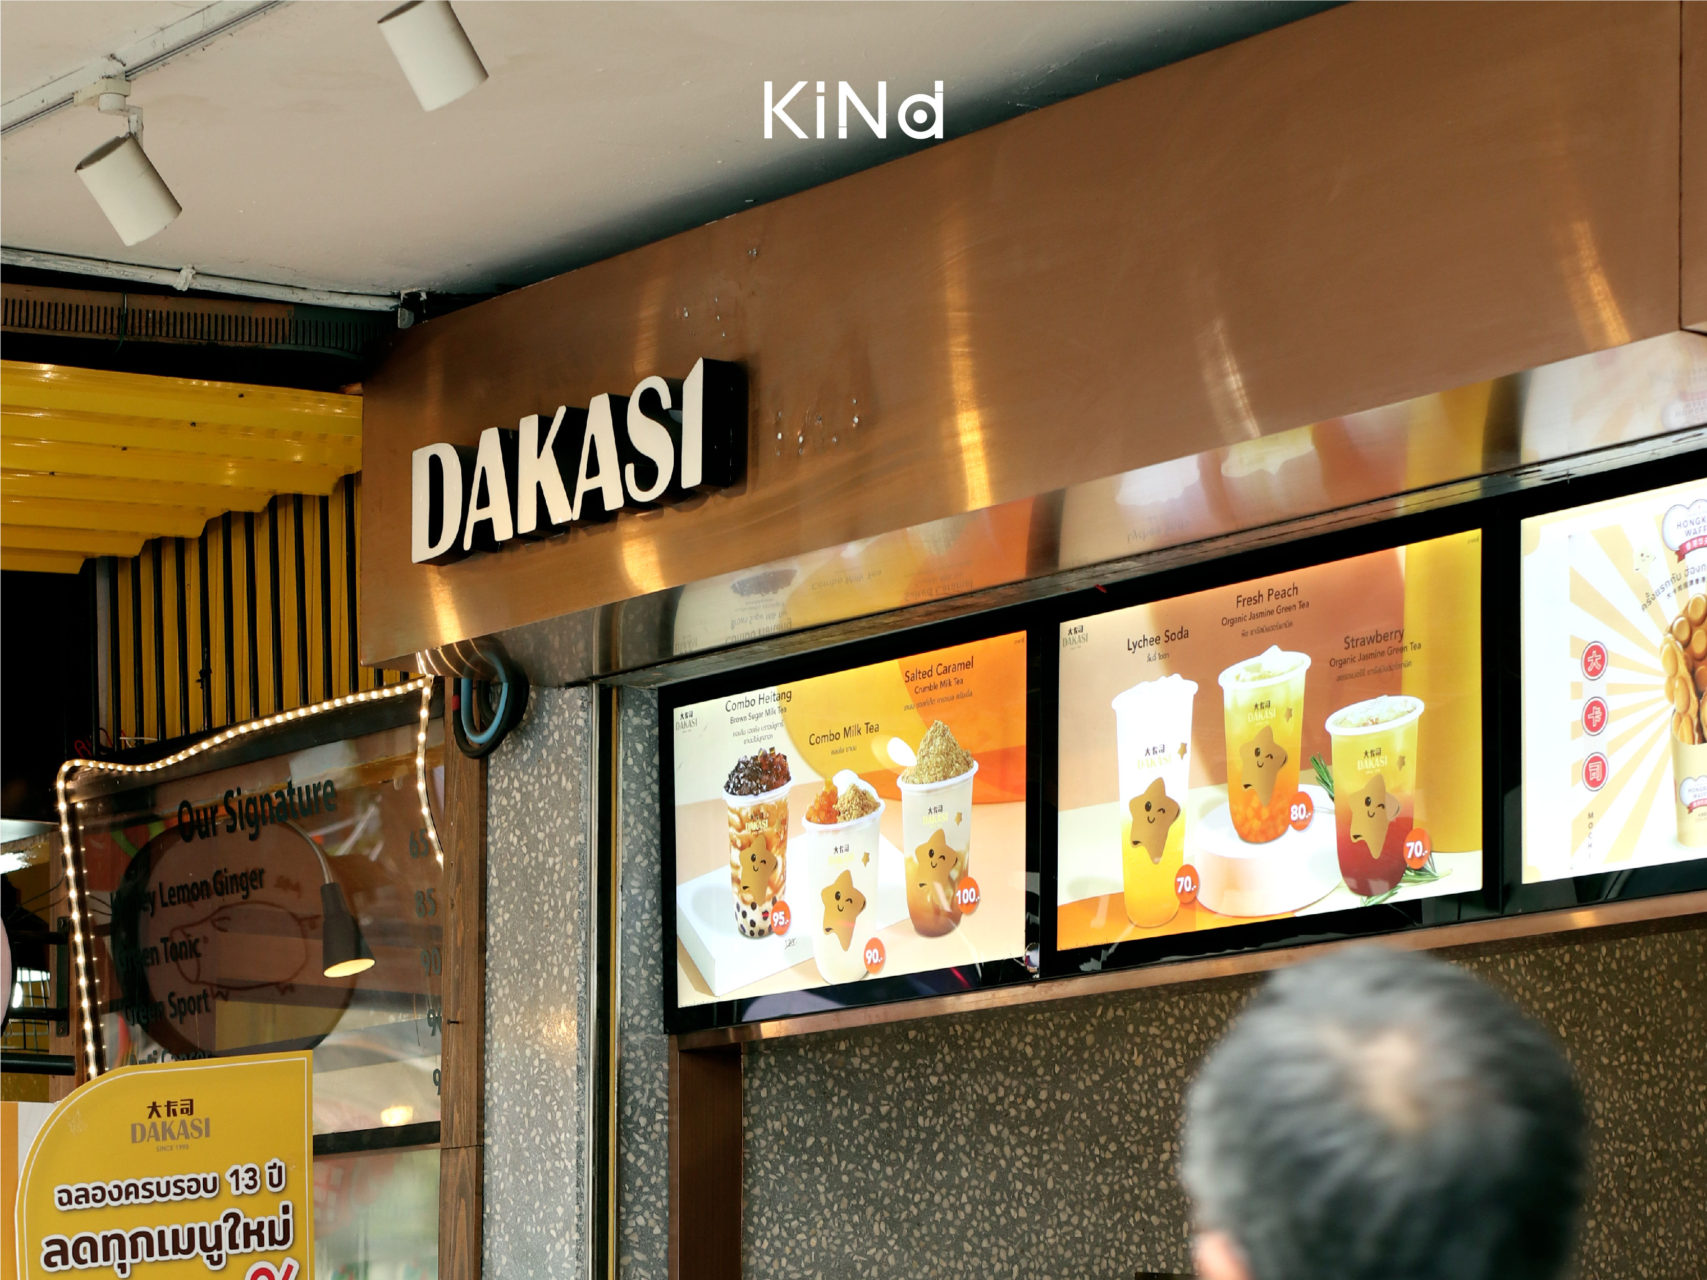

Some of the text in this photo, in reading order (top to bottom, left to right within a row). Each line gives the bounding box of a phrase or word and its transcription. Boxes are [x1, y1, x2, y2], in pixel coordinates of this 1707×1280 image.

[412, 357, 703, 564] DAKASI
[1236, 582, 1299, 608] Fresh Peach
[1221, 600, 1310, 627] Organic Jasmine Green Tea
[1127, 626, 1189, 653] Lychee Soda
[1344, 628, 1404, 650] Strawberry
[1329, 655, 1356, 668] Organic
[1358, 649, 1385, 662] Jasmine
[1410, 641, 1421, 650] Tea
[905, 656, 974, 683] Salted Caramel
[940, 678, 952, 689] Milk
[954, 677, 964, 685] Tea
[725, 690, 792, 713] Combo Heitang
[729, 714, 747, 724] Brown
[748, 711, 764, 722] Sugar
[809, 722, 880, 745] Combo Milk Tea
[178, 779, 336, 842] Our Signature
[1290, 803, 1311, 821] 80.-
[1405, 840, 1428, 859] 70.-
[159, 881, 210, 907] Lemon
[212, 867, 265, 899] Ginger
[956, 887, 981, 905] 100.-
[1176, 875, 1196, 894] 70.-
[772, 909, 790, 927] 95.-
[160, 934, 201, 962] Tonic
[865, 948, 883, 965] 90.-
[168, 988, 210, 1024] Sport
[147, 1098, 194, 1119] 大卡司
[131, 1117, 210, 1144] DAKASI
[58, 1161, 285, 1207] ฉลองครบรอบ 13 ปี
[43, 1205, 291, 1275] ลดทุกเมนูใหม่
